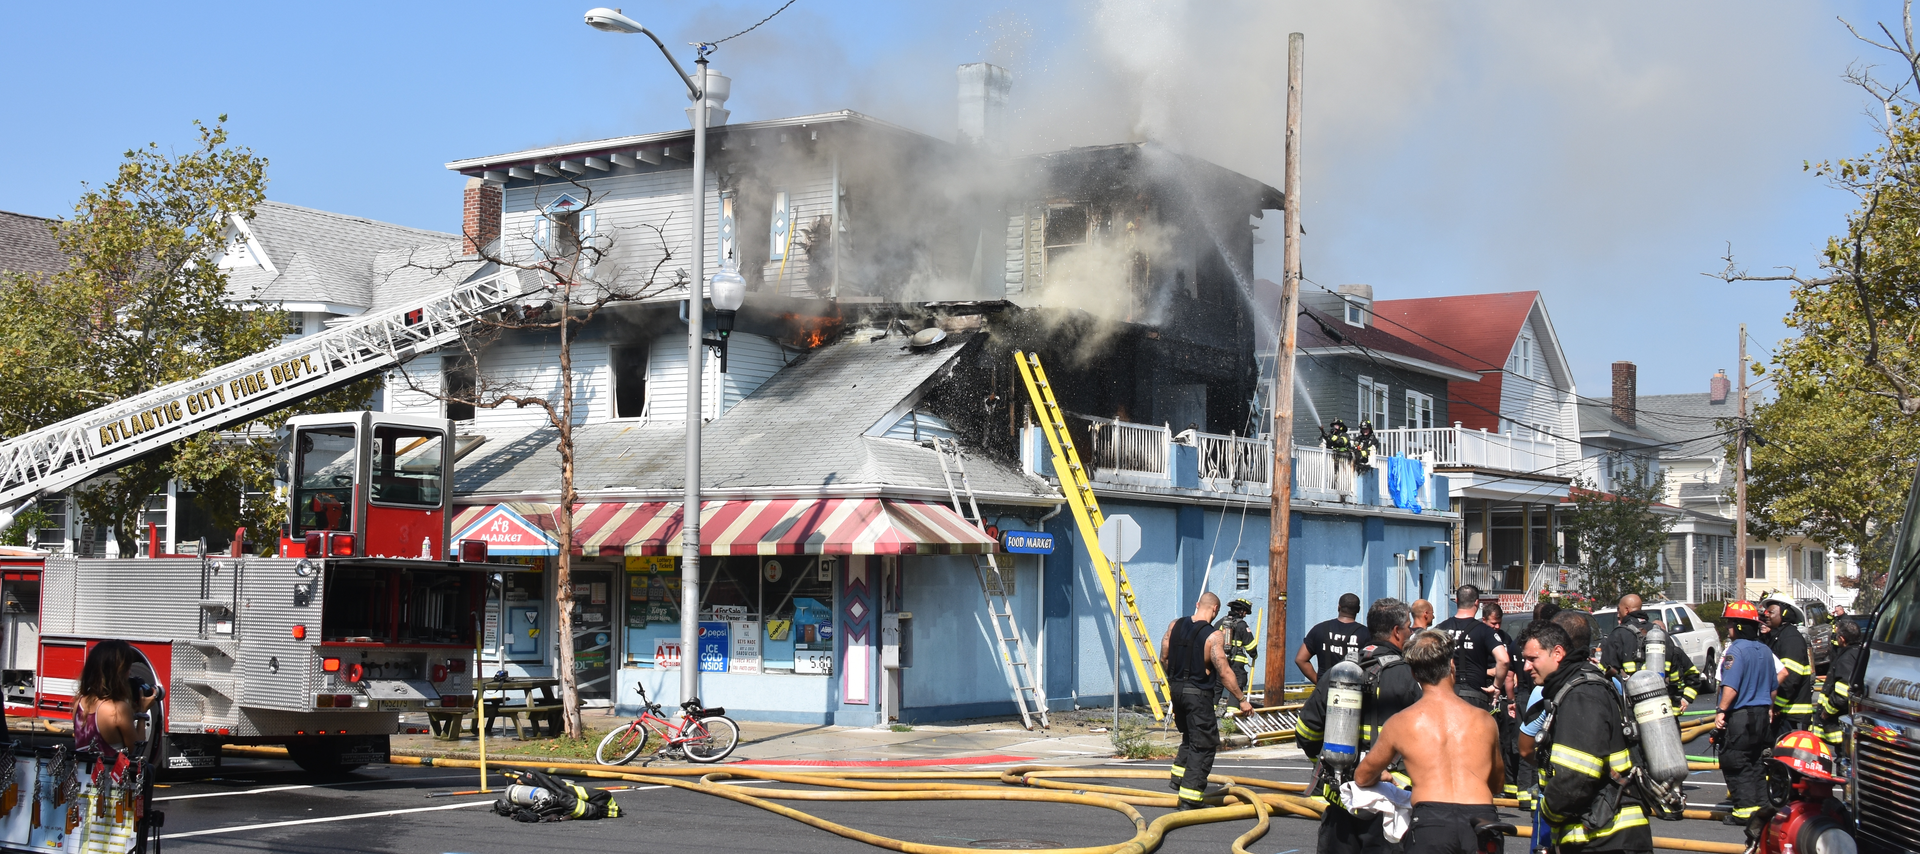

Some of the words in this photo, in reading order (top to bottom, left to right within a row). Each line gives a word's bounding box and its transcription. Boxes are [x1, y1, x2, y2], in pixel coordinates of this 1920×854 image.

[99, 400, 183, 448] ATLANTIC
[186, 383, 226, 415] CITY
[230, 370, 268, 400] FIRE
[270, 354, 318, 386] DEPT.
[480, 533, 522, 543] MARKET
[1007, 536, 1025, 548] FOOD
[1025, 537, 1053, 549] MARKET
[707, 629, 727, 638] pepsi
[705, 644, 719, 653] ICE
[700, 653, 723, 662] COLD
[700, 661, 724, 671] INSIDE
